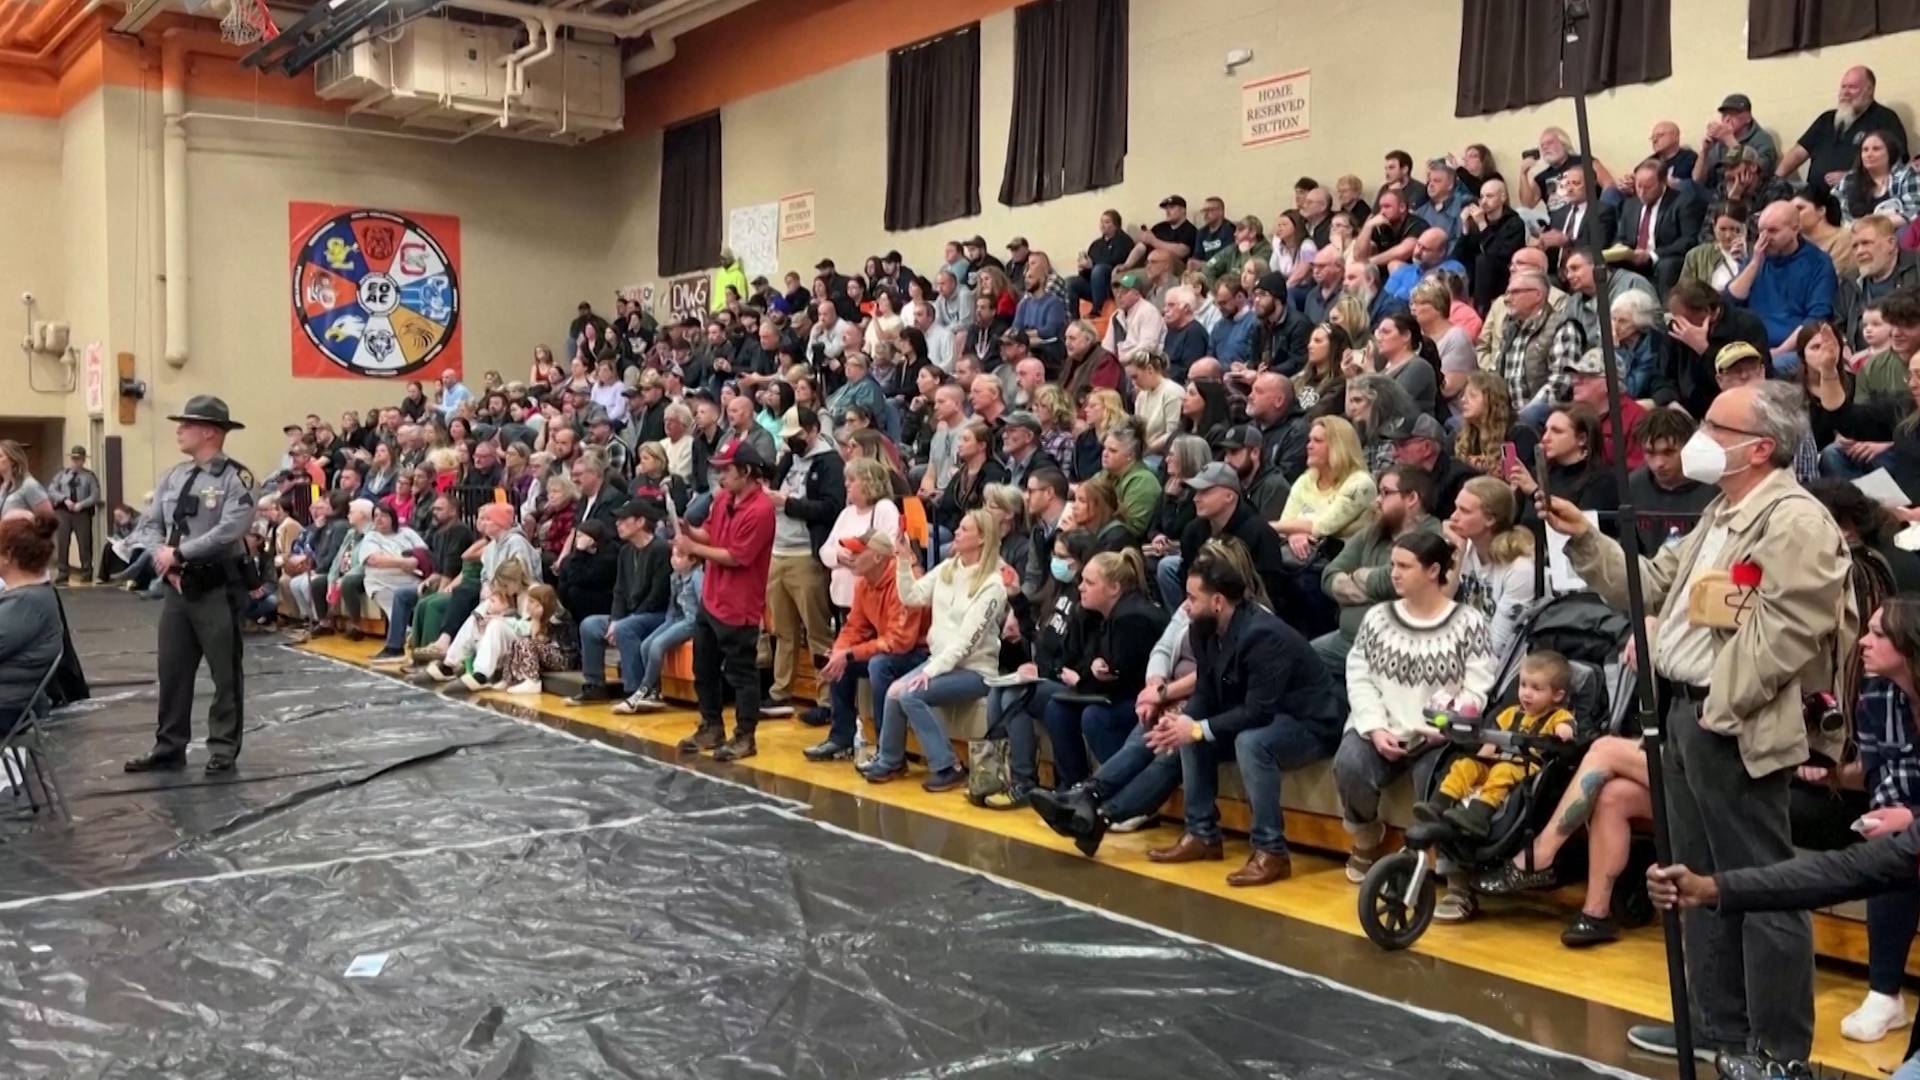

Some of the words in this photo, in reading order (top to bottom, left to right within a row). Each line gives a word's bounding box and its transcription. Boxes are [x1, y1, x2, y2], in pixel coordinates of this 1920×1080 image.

[1258, 84, 1293, 103] HOME
[1247, 98, 1305, 122] RESERVED
[1251, 115, 1300, 136] SECTION
